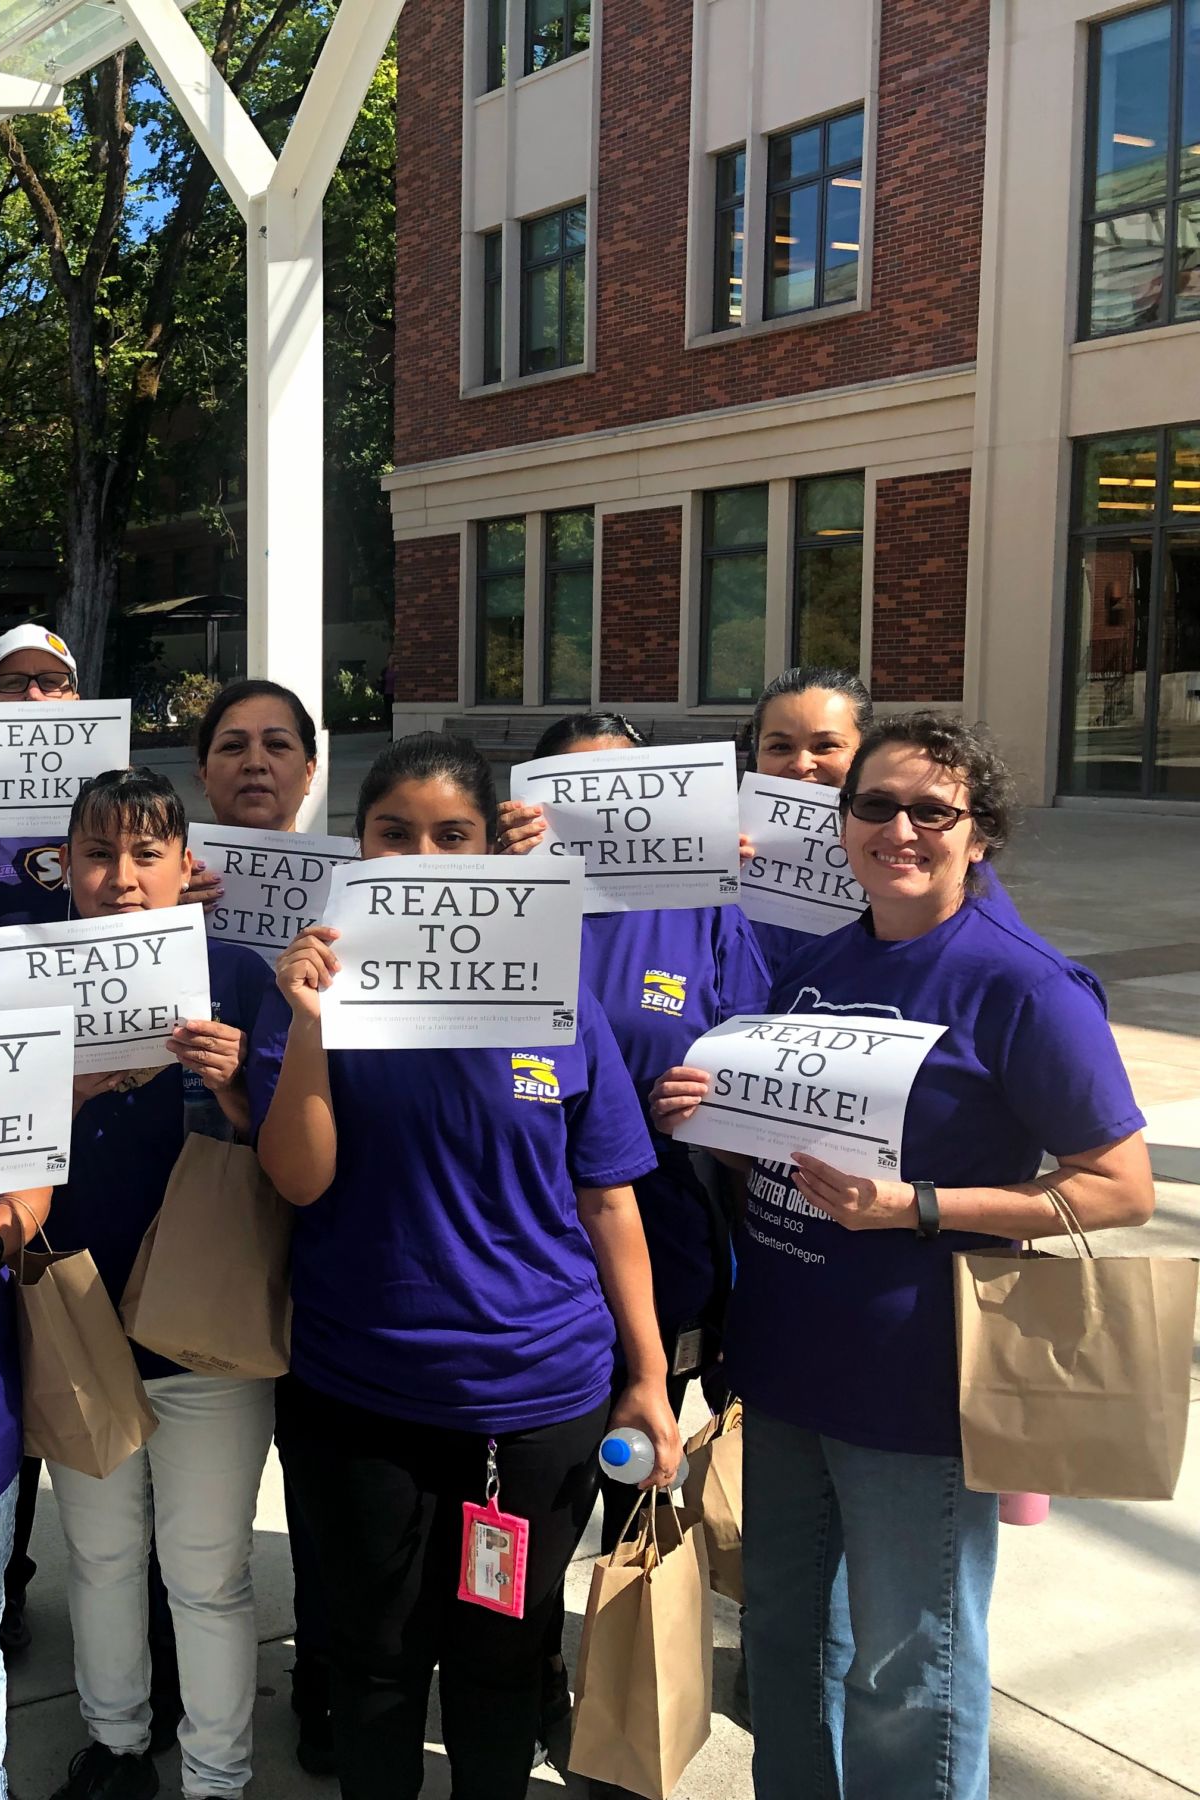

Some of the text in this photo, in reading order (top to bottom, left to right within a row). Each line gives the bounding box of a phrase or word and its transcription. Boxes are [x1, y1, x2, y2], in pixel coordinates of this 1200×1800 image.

[19, 750, 63, 774] TO
[552, 770, 694, 804] READY
[597, 806, 651, 834] TO
[768, 800, 840, 837] REA
[550, 836, 704, 865] STRIKE!
[803, 837, 848, 868] TO
[224, 850, 348, 882] READ
[749, 856, 870, 904] STRIK
[261, 884, 308, 910] TO
[368, 885, 535, 917] READY
[213, 908, 317, 939] STRIK
[419, 924, 481, 953] TO
[26, 937, 166, 979] READY
[360, 960, 538, 991] STRIKE!
[645, 969, 671, 978] LOCAL
[73, 977, 128, 1007] TO
[641, 993, 685, 1011] SEIU
[75, 1004, 180, 1037] RIKE!
[745, 1024, 891, 1056] READY
[511, 1052, 540, 1061] LOCAL
[774, 1048, 826, 1077] TO
[513, 1080, 560, 1097] SEIU
[715, 1069, 869, 1125] STRIKE!
[46, 1162, 66, 1170] SEIU
[877, 1159, 897, 1168] SEIU
[754, 1174, 787, 1207] BETTER
[786, 1188, 838, 1221] OREG
[759, 1207, 782, 1226] Local
[783, 1217, 804, 1233] 503
